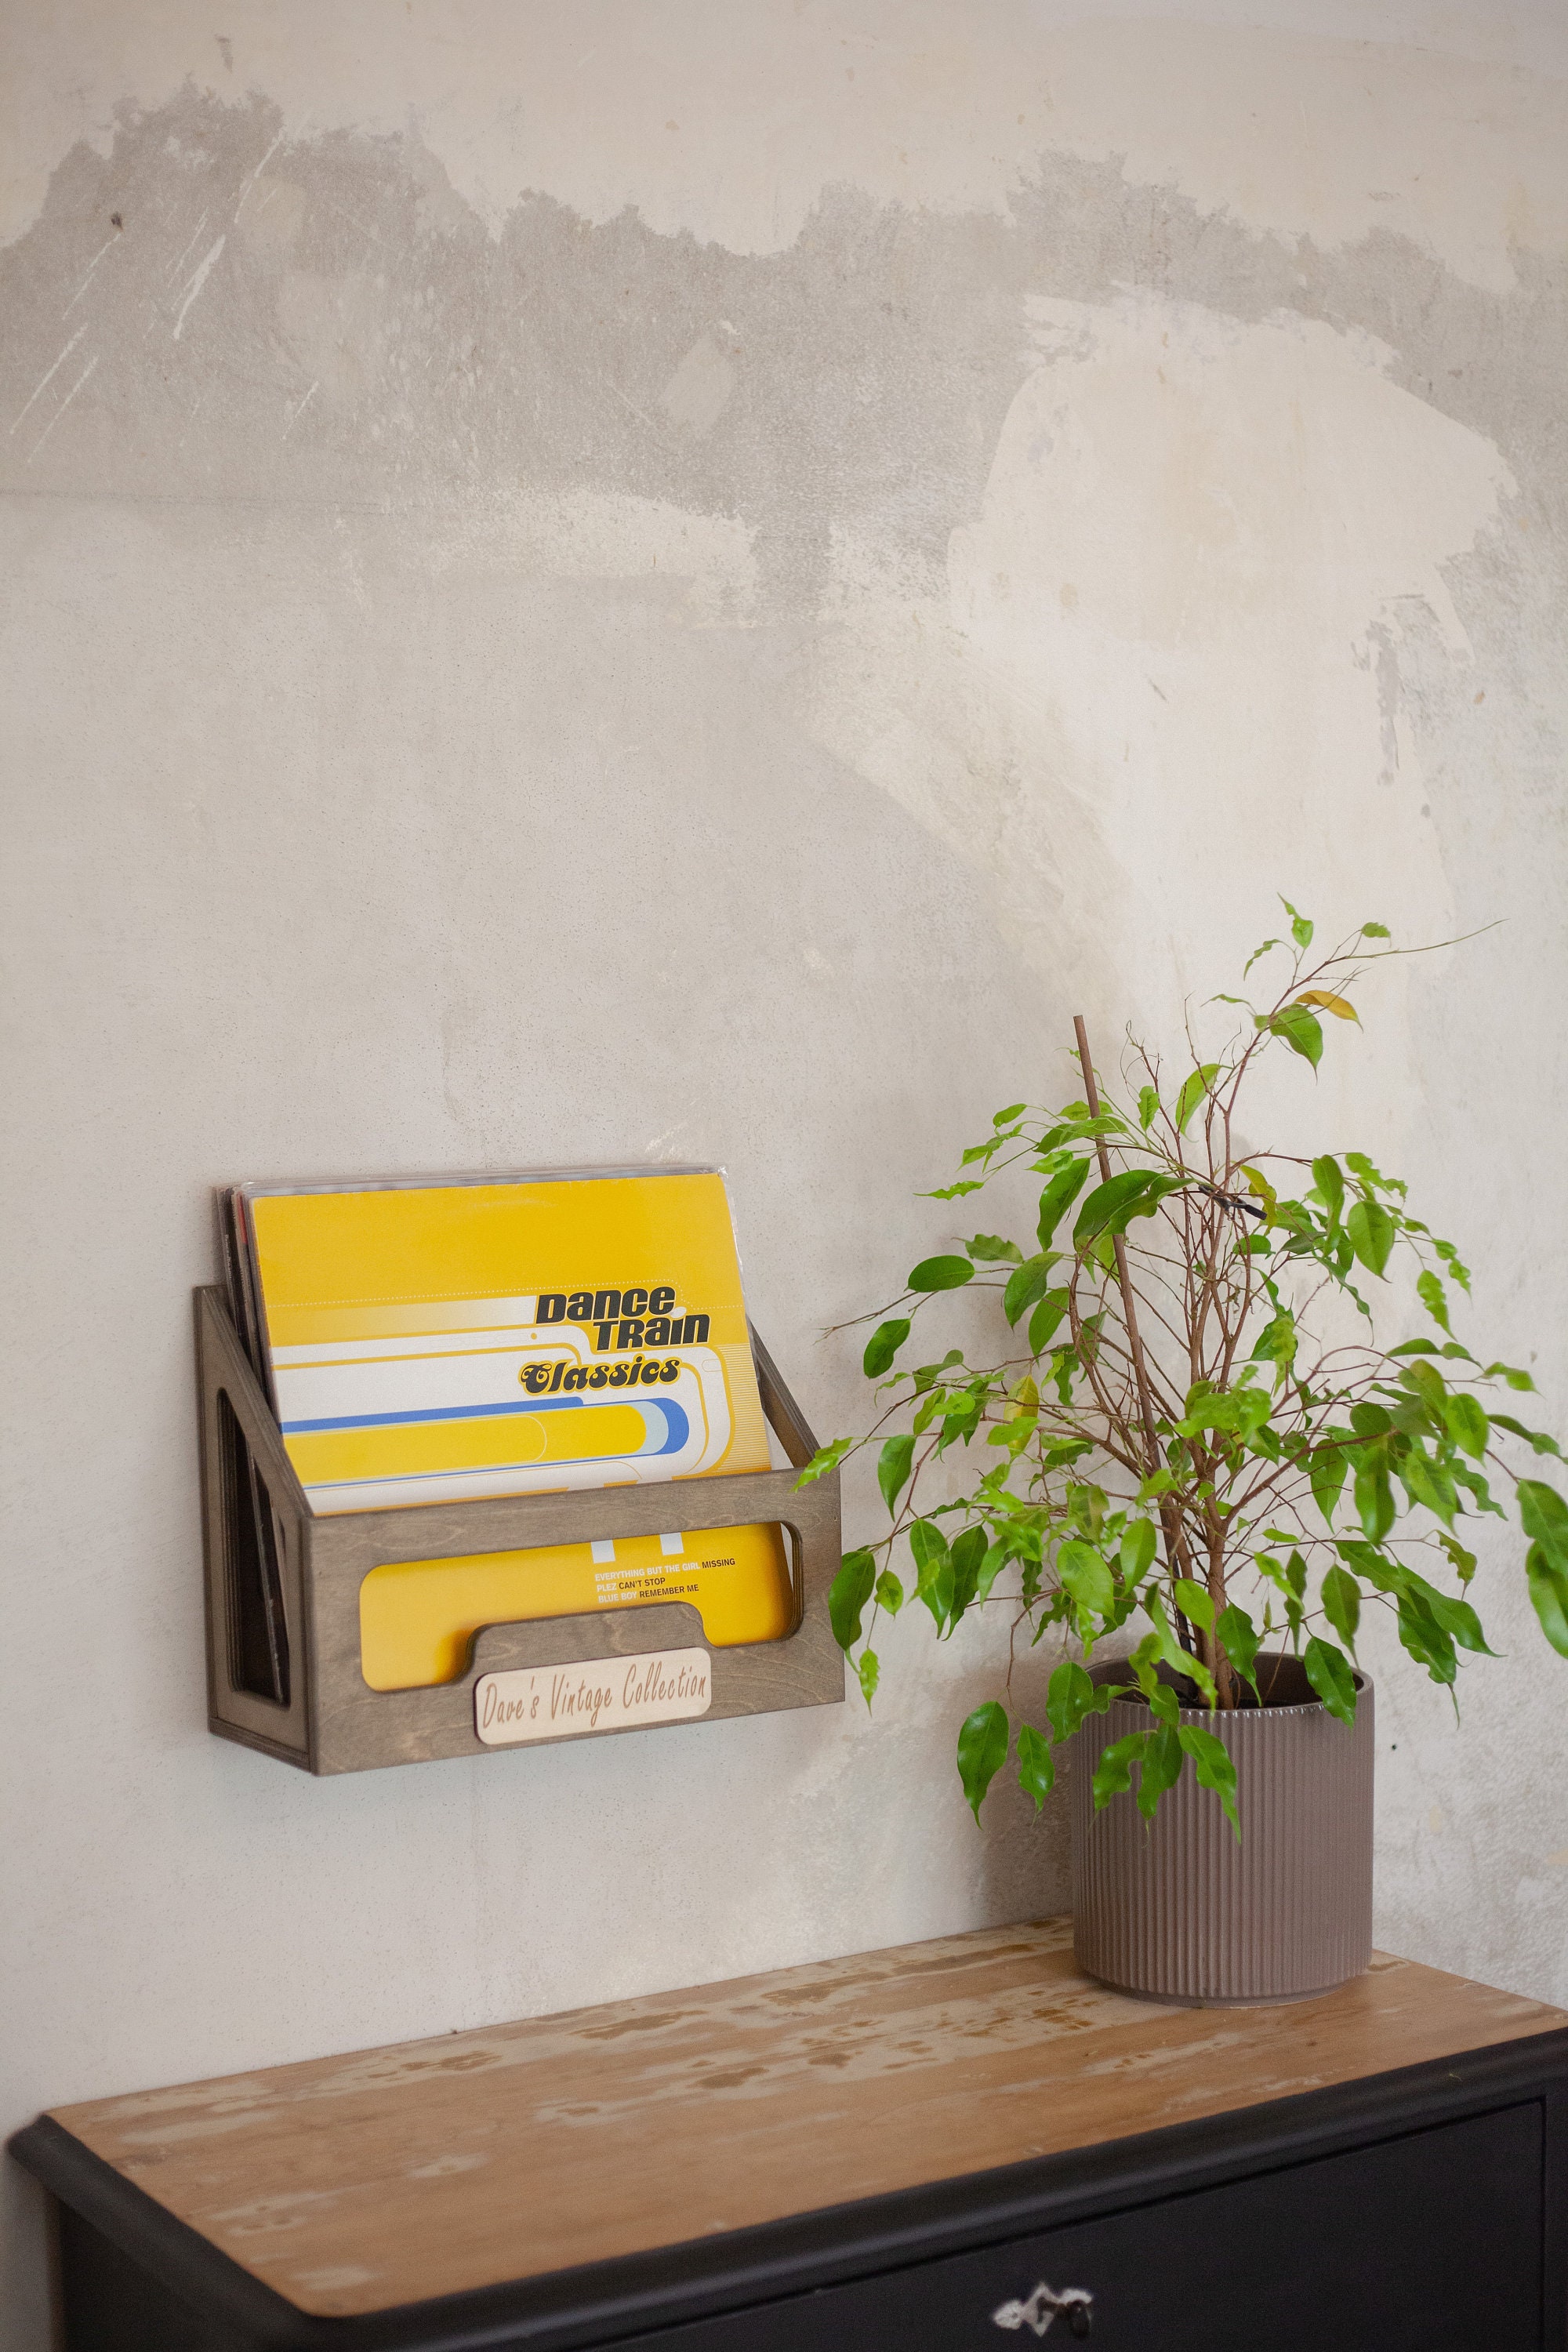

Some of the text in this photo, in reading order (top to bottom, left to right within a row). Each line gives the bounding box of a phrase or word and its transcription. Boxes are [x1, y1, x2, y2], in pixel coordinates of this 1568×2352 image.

[535, 1286, 676, 1324] Dance
[521, 1356, 681, 1394] Classics
[594, 1558, 735, 1581] EVERYTHING BUT THE GIRL MISSING
[596, 1577, 666, 1592] PLEZ CAN'T STOP
[598, 1584, 699, 1603] BLUE BOY REMEMBER ME
[483, 1661, 706, 1730] Dave's Vintage Collection
